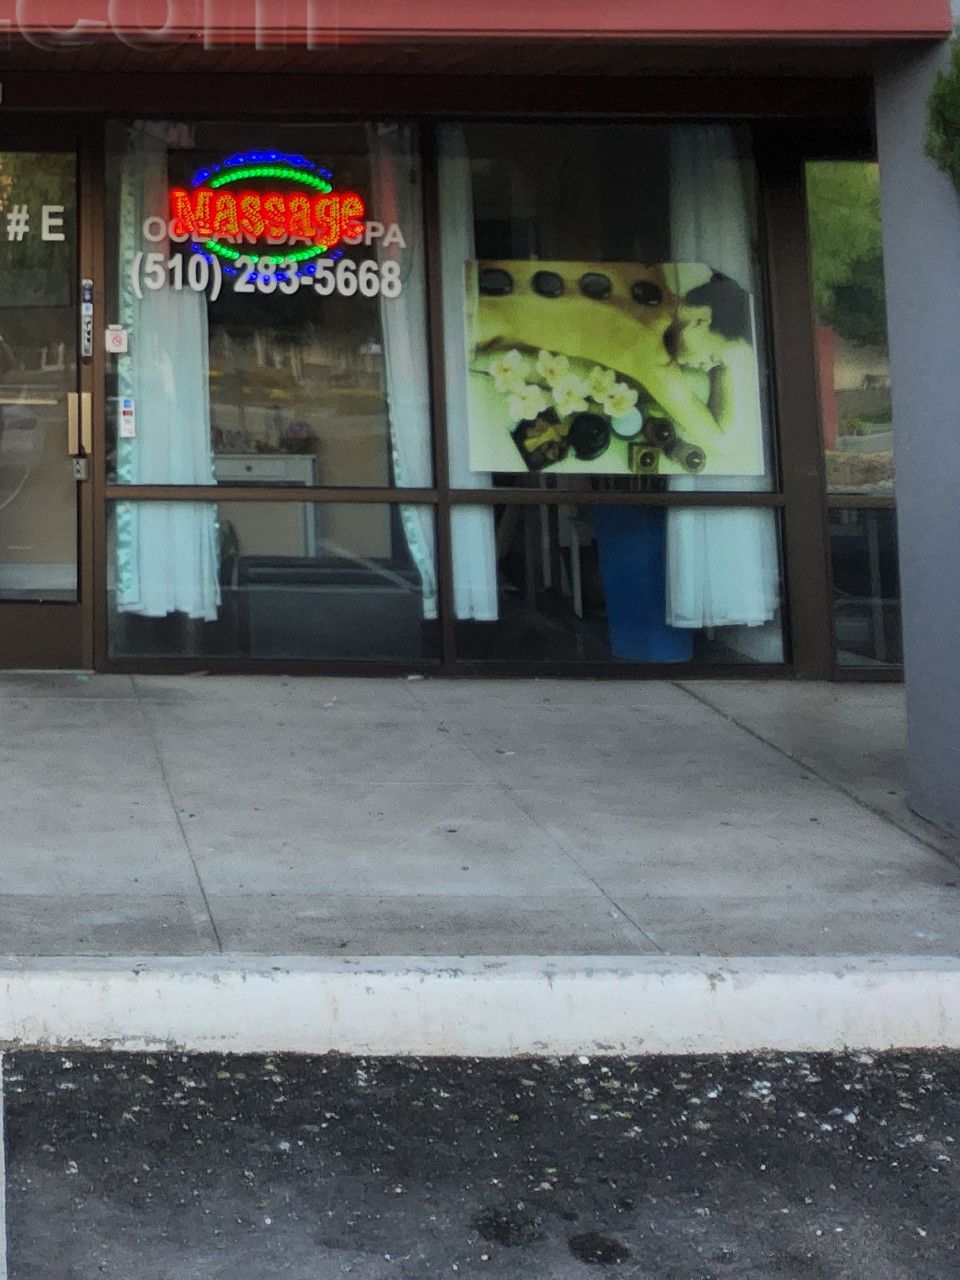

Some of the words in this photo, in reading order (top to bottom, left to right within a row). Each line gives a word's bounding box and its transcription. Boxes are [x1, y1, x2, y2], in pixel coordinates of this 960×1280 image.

[6, 204, 30, 241] #
[41, 204, 66, 241] E
[171, 188, 365, 247] Massage
[131, 251, 223, 302] (510)
[233, 254, 403, 298] 283-5668
